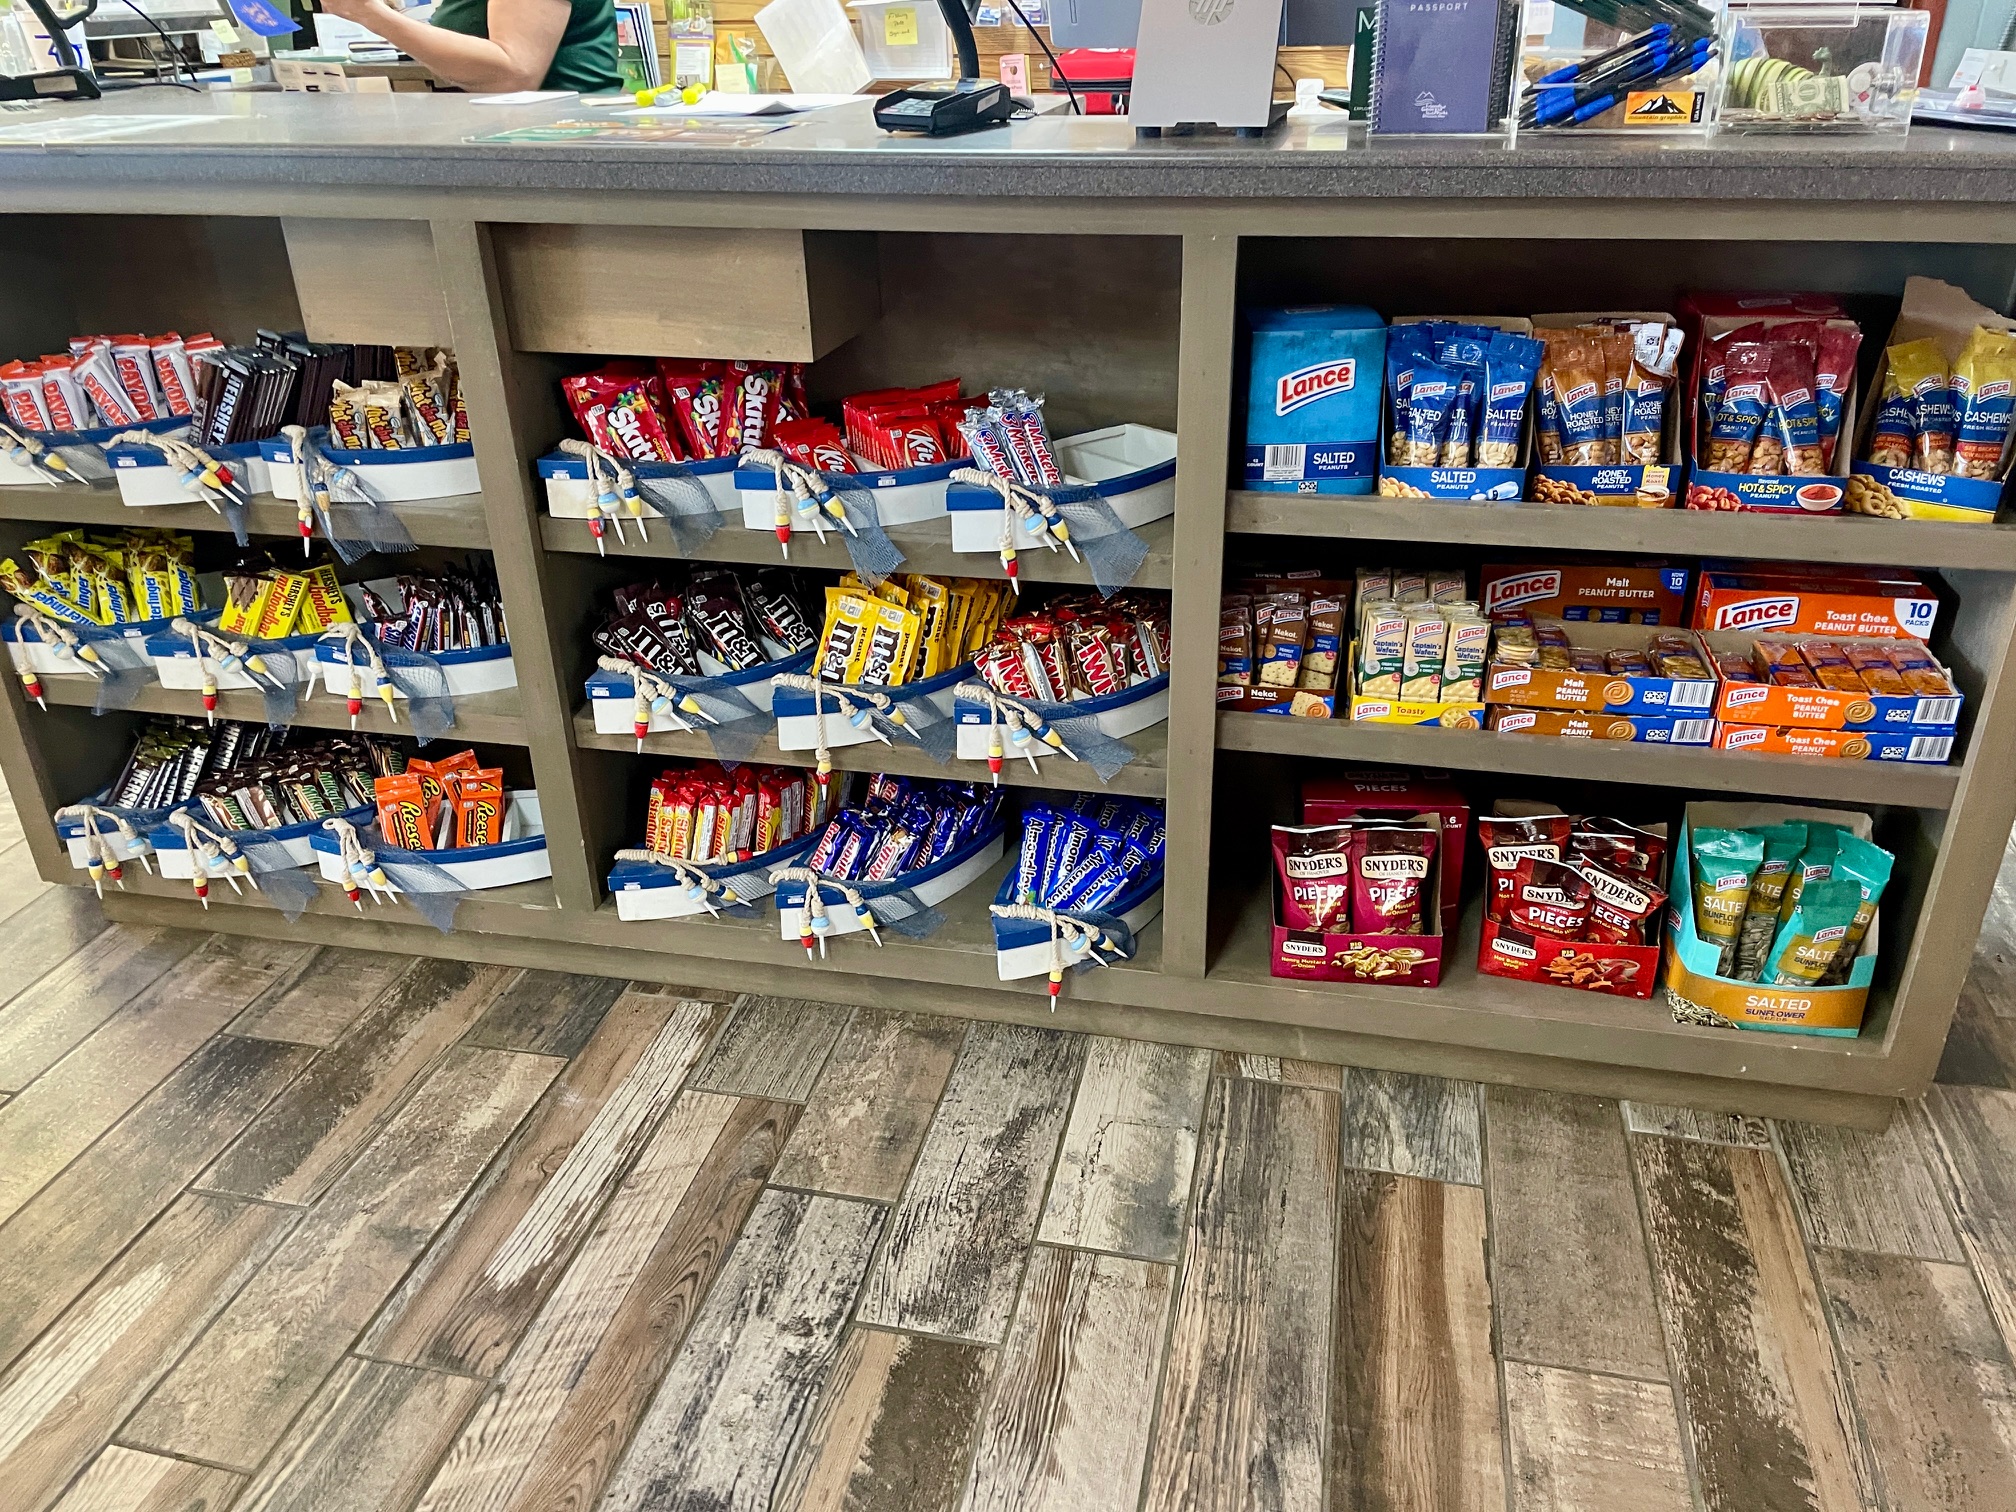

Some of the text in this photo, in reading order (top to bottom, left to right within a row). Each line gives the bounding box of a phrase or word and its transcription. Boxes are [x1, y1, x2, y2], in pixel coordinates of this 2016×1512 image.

[1410, 2, 1468, 12] PASSPORT
[1282, 366, 1351, 403] Lance
[1414, 383, 1444, 396] Lance
[1493, 384, 1524, 397] Lance
[1978, 381, 2010, 398] Lance
[84, 373, 133, 426] PAYDA
[1567, 385, 1596, 404] Lance
[1726, 387, 1759, 400] Lance
[11, 391, 47, 431] PAY
[43, 380, 77, 431] PAYD
[211, 374, 243, 446] HERSHEY
[740, 375, 769, 455] Skittl
[1410, 408, 1442, 421] SALTED
[1486, 408, 1524, 420] SALTED
[1569, 410, 1599, 421] HONEY
[1736, 414, 1763, 425] SPICY
[1964, 411, 2012, 424] CASHEWS
[1566, 416, 1604, 429] ROASTED
[607, 407, 658, 462] Skitt
[1313, 452, 1355, 465] SALTED
[1431, 471, 1476, 484] SALTED
[1597, 470, 1629, 478] HONEY
[1889, 468, 1946, 487] CASHEWS
[1739, 483, 1796, 495] HOT SPICY
[1887, 481, 1942, 494] FRESH ROASTED
[320, 569, 342, 604] HERSHEY'S
[1363, 578, 1389, 590] Lance
[1435, 580, 1461, 592] Lance
[1606, 577, 1630, 587] Malt
[1671, 577, 1683, 586] 10
[1490, 576, 1556, 604] Lance
[1578, 588, 1655, 599] PEANUT BUTTER
[281, 579, 303, 618] HERSHEY'S
[952, 595, 964, 631] peanut
[1312, 602, 1338, 611] Lance
[1910, 602, 1932, 618] 10
[1276, 611, 1302, 619] Lance
[1719, 602, 1793, 630] Lance
[1826, 610, 1888, 624] Toast Chee
[1375, 622, 1403, 634] Lance
[1414, 623, 1442, 636] Lance
[1814, 621, 1897, 634] PEANUT BUTTER
[1905, 619, 1929, 627] PACKS
[1457, 627, 1486, 640] Lance
[854, 626, 868, 663] peanut
[898, 632, 911, 668] peanut
[1373, 640, 1403, 648] Captain's
[1412, 642, 1442, 650] Captain's
[1454, 646, 1484, 654] Captain's
[1495, 672, 1528, 685] Lance
[1563, 678, 1584, 687] Malt
[1556, 687, 1589, 696] PEANUT
[1556, 694, 1587, 702] BUTTER
[1730, 689, 1765, 702] Lance
[1787, 694, 1840, 706] Toast Chee
[1357, 705, 1388, 716] Lance
[1396, 706, 1426, 716] Toasty
[1793, 704, 1829, 713] PEANUT
[1501, 715, 1534, 729] Lance
[1793, 711, 1826, 720] BUTTER
[1568, 720, 1589, 728] Malt
[1560, 728, 1593, 736] PEANUT
[1729, 731, 1764, 744] Lance
[1785, 735, 1836, 746] Toast Chee
[1791, 745, 1826, 753] PEANUT
[115, 768, 151, 809] HERSH
[1354, 784, 1407, 792] PIECES
[400, 801, 425, 850] Reese'
[475, 800, 496, 844] Reese
[1449, 816, 1457, 824] 6
[1288, 856, 1343, 871] SNYDER'S
[1365, 859, 1424, 872] SNYDER'S
[1805, 867, 1830, 877] Lance
[1718, 876, 1747, 888] Lance
[1584, 871, 1645, 907] SNYDER'S
[1703, 896, 1745, 914] SALTE
[1529, 907, 1584, 928] PIECES
[1816, 928, 1844, 940] Lance
[1285, 943, 1324, 954] SNYDER'S
[1494, 942, 1534, 957] SNYDER'S
[1796, 947, 1836, 961] SALTE
[1503, 962, 1520, 970] Wing
[1746, 995, 1811, 1011] SALTED
[1745, 1009, 1806, 1019] SUNFLOWER
